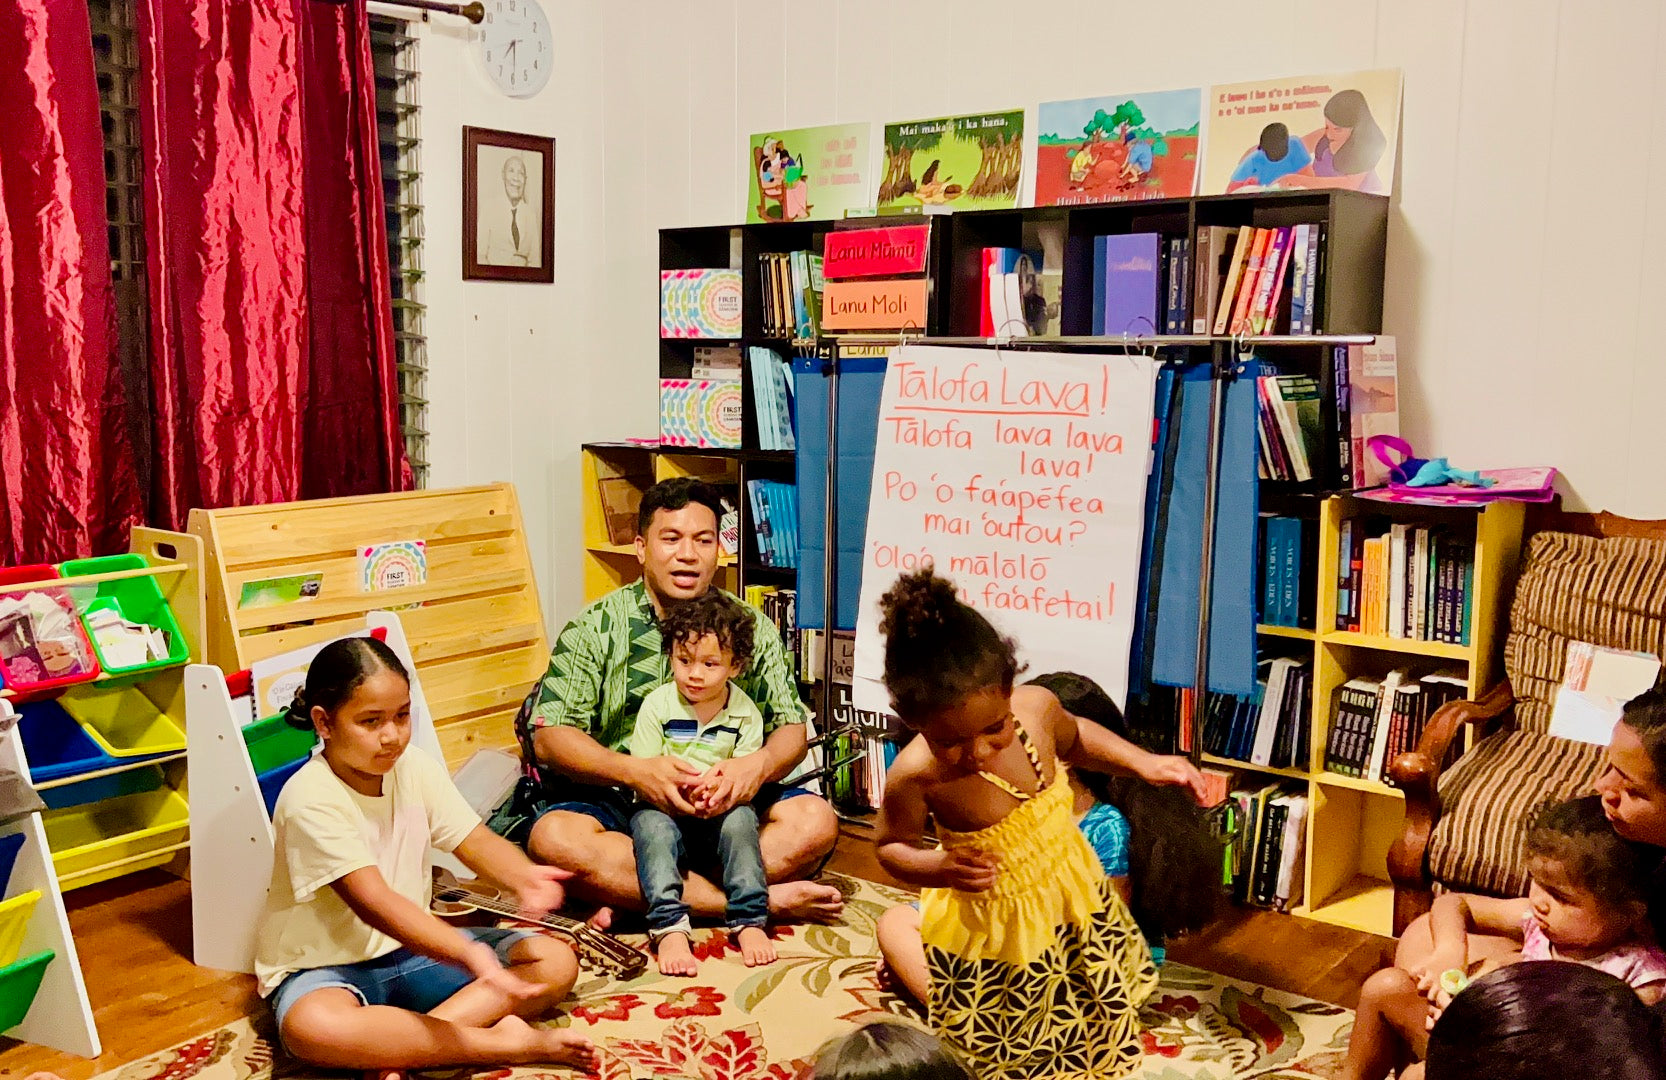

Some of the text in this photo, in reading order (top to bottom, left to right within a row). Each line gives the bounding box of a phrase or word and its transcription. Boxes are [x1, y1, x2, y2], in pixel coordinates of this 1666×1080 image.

[899, 125, 918, 136] Mai
[966, 119, 978, 129] ka
[982, 117, 1009, 128] hana,
[1085, 195, 1099, 204] ka
[1103, 193, 1128, 203] lima
[828, 243, 866, 263] Lanu
[830, 294, 908, 316] Lanu Moli
[893, 362, 1109, 415] Tālofa Lava!
[885, 417, 1123, 455] Tālofa lava lava
[1020, 451, 1094, 481] lava!
[885, 471, 917, 501] Po
[924, 512, 970, 535] mai
